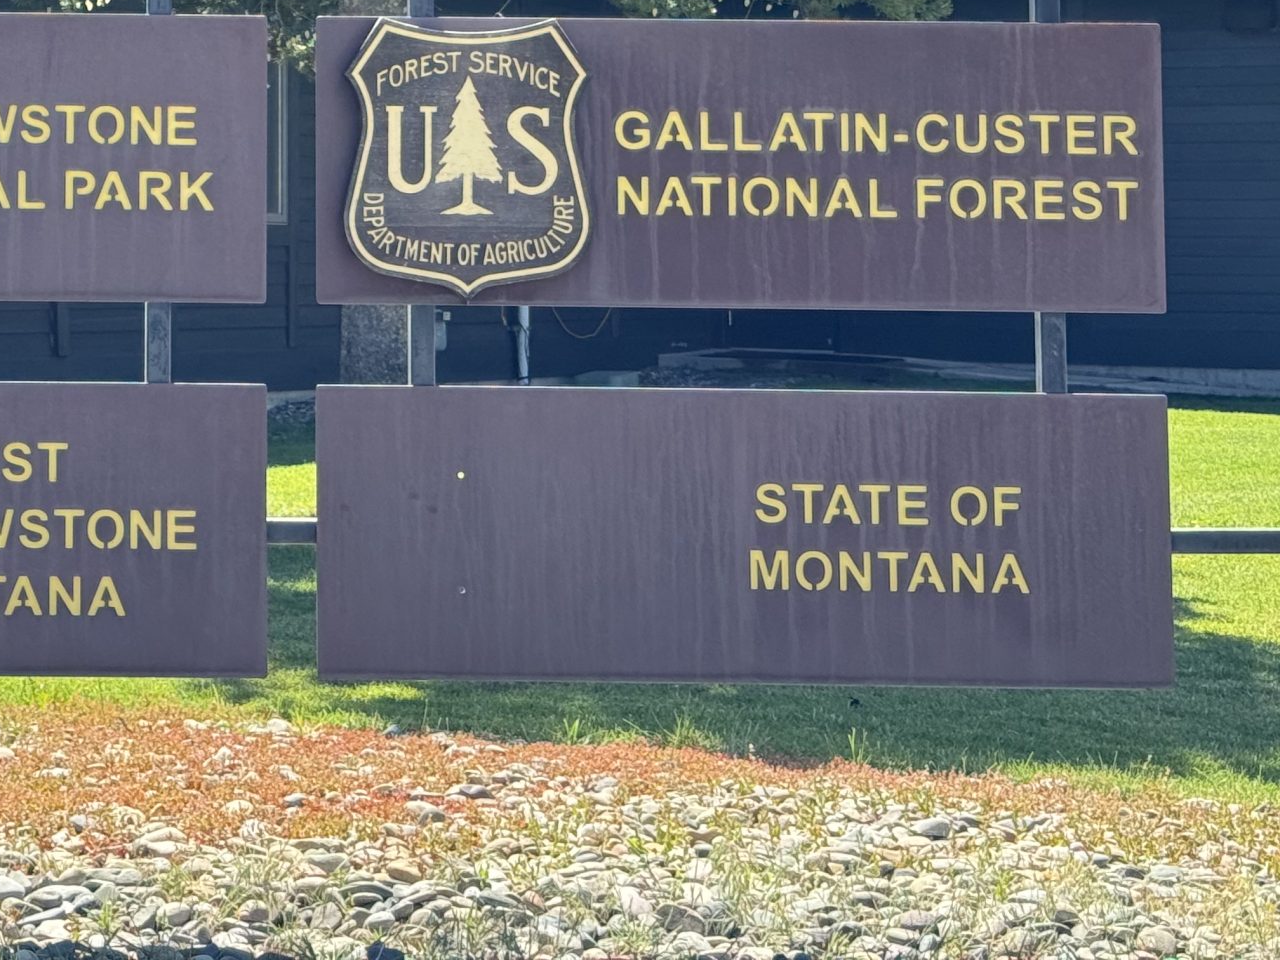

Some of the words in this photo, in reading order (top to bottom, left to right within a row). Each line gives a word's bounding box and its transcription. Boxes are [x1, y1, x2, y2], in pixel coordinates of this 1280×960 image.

[376, 51, 462, 97] FOREST
[468, 51, 561, 97] SERVICE
[614, 110, 1137, 155] GALLATIN-CUSTER
[64, 169, 213, 211] PARK
[617, 175, 897, 219] NATIONAL
[916, 178, 1137, 221] FOREST
[362, 192, 454, 266] DEPARTMENT
[457, 243, 479, 266] OF
[483, 195, 575, 266] AGRICULTURE
[755, 483, 928, 526] STATE
[950, 485, 1020, 526] OF
[749, 549, 1028, 593] MONTANA
